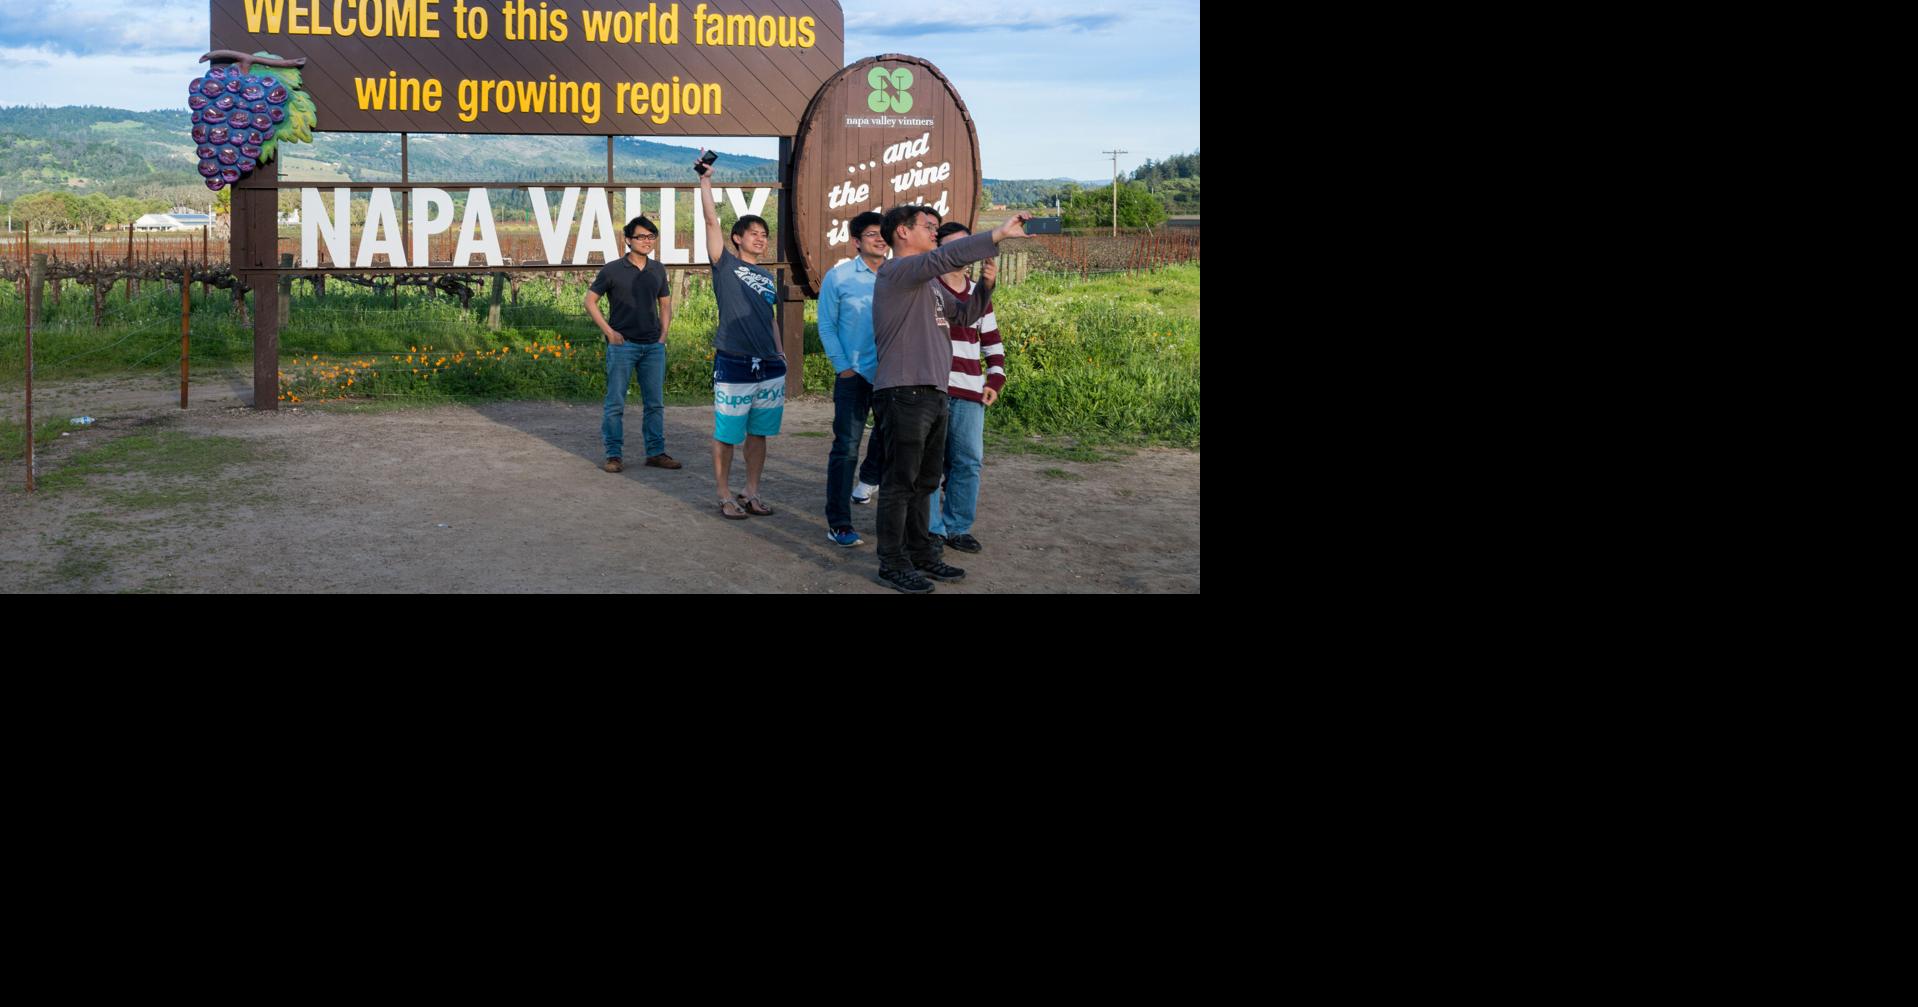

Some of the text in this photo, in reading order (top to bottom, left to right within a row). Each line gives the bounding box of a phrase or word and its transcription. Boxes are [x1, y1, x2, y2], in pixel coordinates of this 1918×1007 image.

[243, 0, 818, 49] WELCOME to this world famous
[354, 70, 724, 125] wine growing region
[846, 115, 934, 128] napa valley vintners
[883, 132, 931, 165] and
[827, 180, 870, 210] the
[890, 161, 951, 194] wine
[301, 187, 506, 268] NAPA
[826, 218, 850, 247] is
